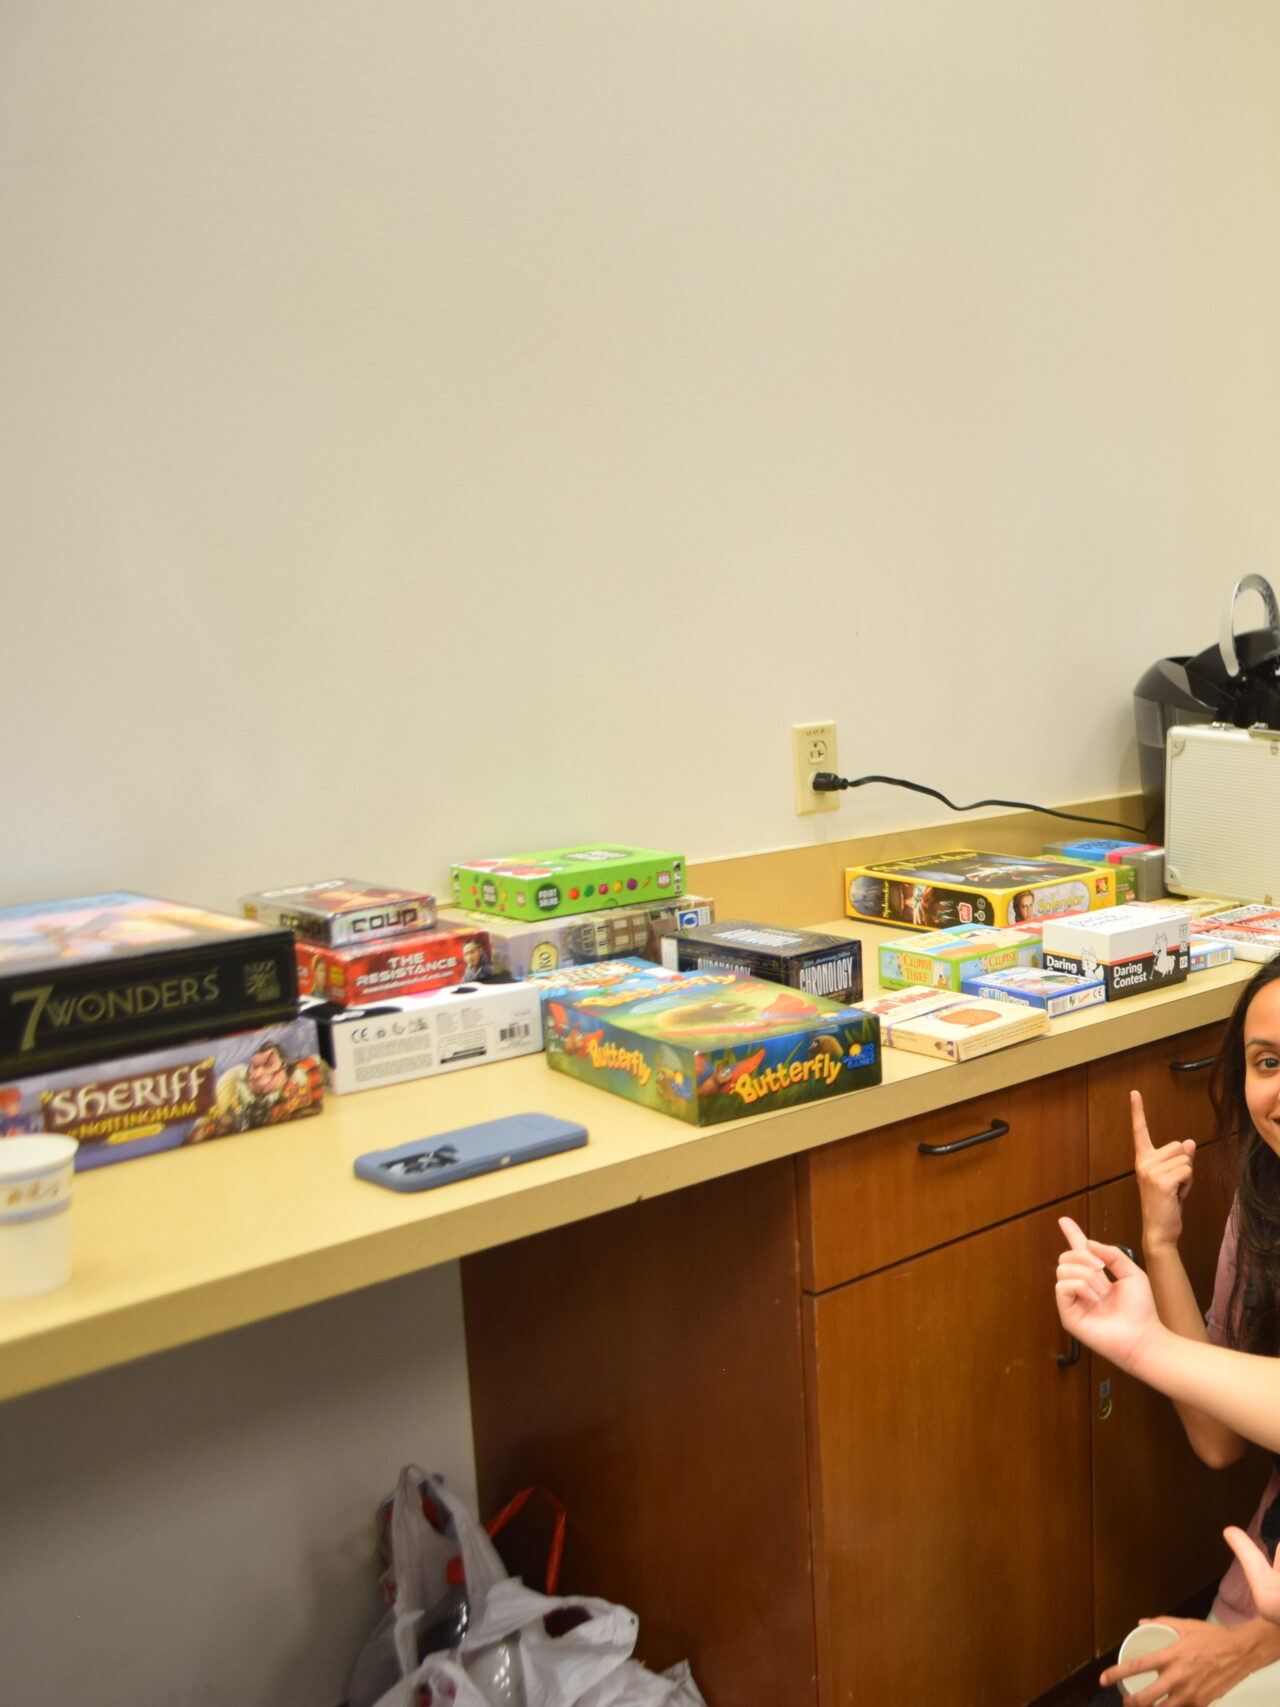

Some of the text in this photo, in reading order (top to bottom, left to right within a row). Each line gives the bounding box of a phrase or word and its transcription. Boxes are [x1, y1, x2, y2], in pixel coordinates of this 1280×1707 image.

[356, 957, 457, 986] RESISTANCE
[388, 952, 425, 968] THE
[1046, 956, 1077, 971] Daring
[1113, 962, 1143, 978] Daring
[800, 956, 853, 997] CHRONOLOGY
[1113, 973, 1147, 989] Contest
[11, 968, 220, 1051] 7 WONDERS
[587, 1038, 651, 1087] Butterfly
[730, 1054, 842, 1104] Butterfly
